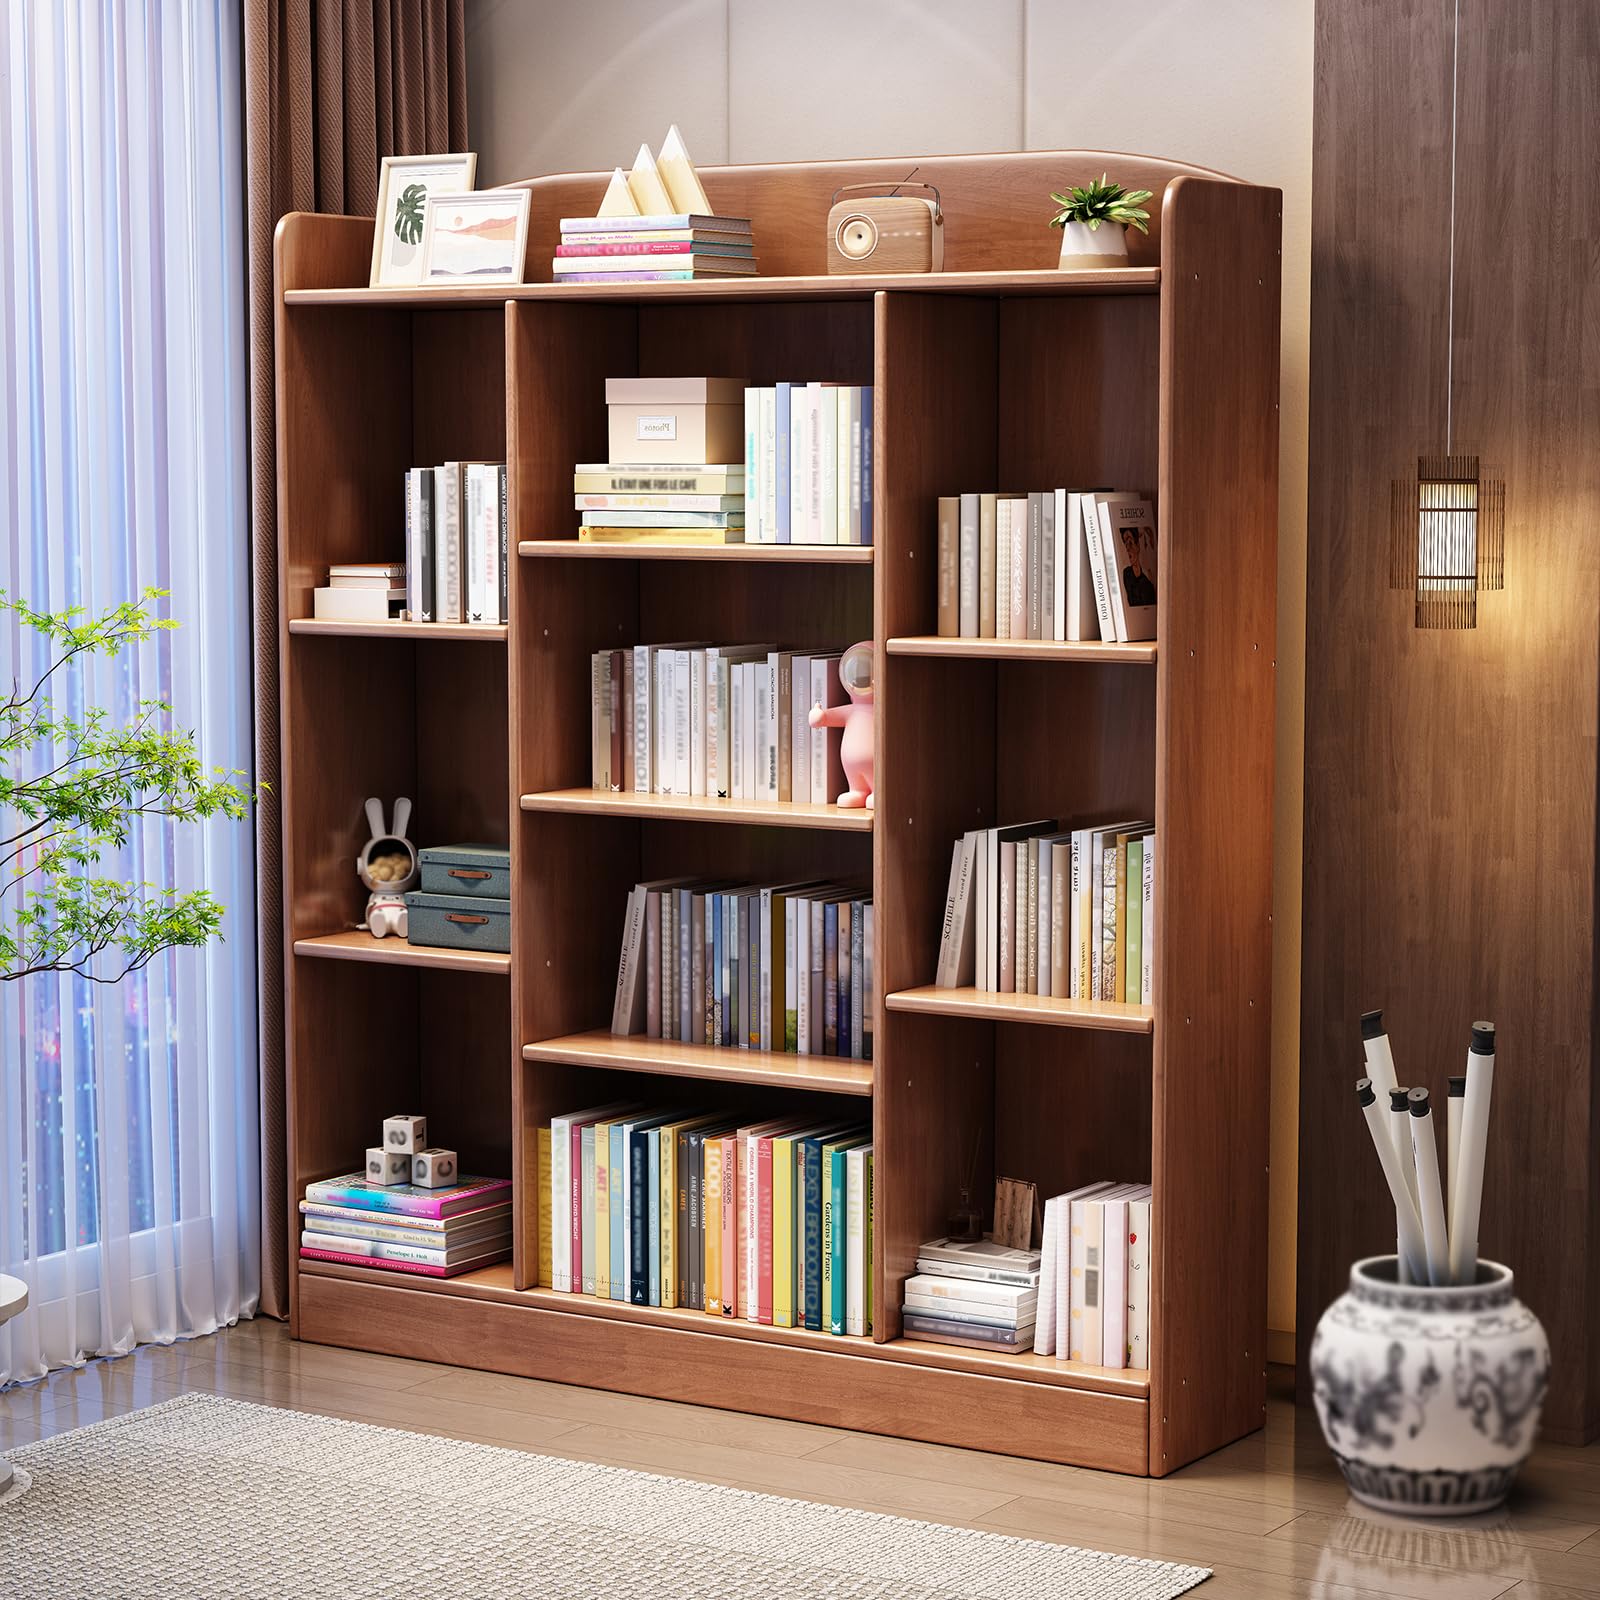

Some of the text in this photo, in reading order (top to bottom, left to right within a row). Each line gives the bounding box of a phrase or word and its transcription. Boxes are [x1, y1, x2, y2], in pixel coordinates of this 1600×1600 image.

[718, 790, 727, 798] K
[944, 896, 955, 940] SCHIELE
[806, 1143, 819, 1319] ALEXEY BRODOVITCH
[825, 1202, 833, 1281] Gardens in France
[386, 1249, 410, 1258] Penelope
[416, 1252, 428, 1260] Holt
[709, 1298, 719, 1309] K
[723, 1304, 732, 1315] K
[832, 1321, 841, 1332] K
